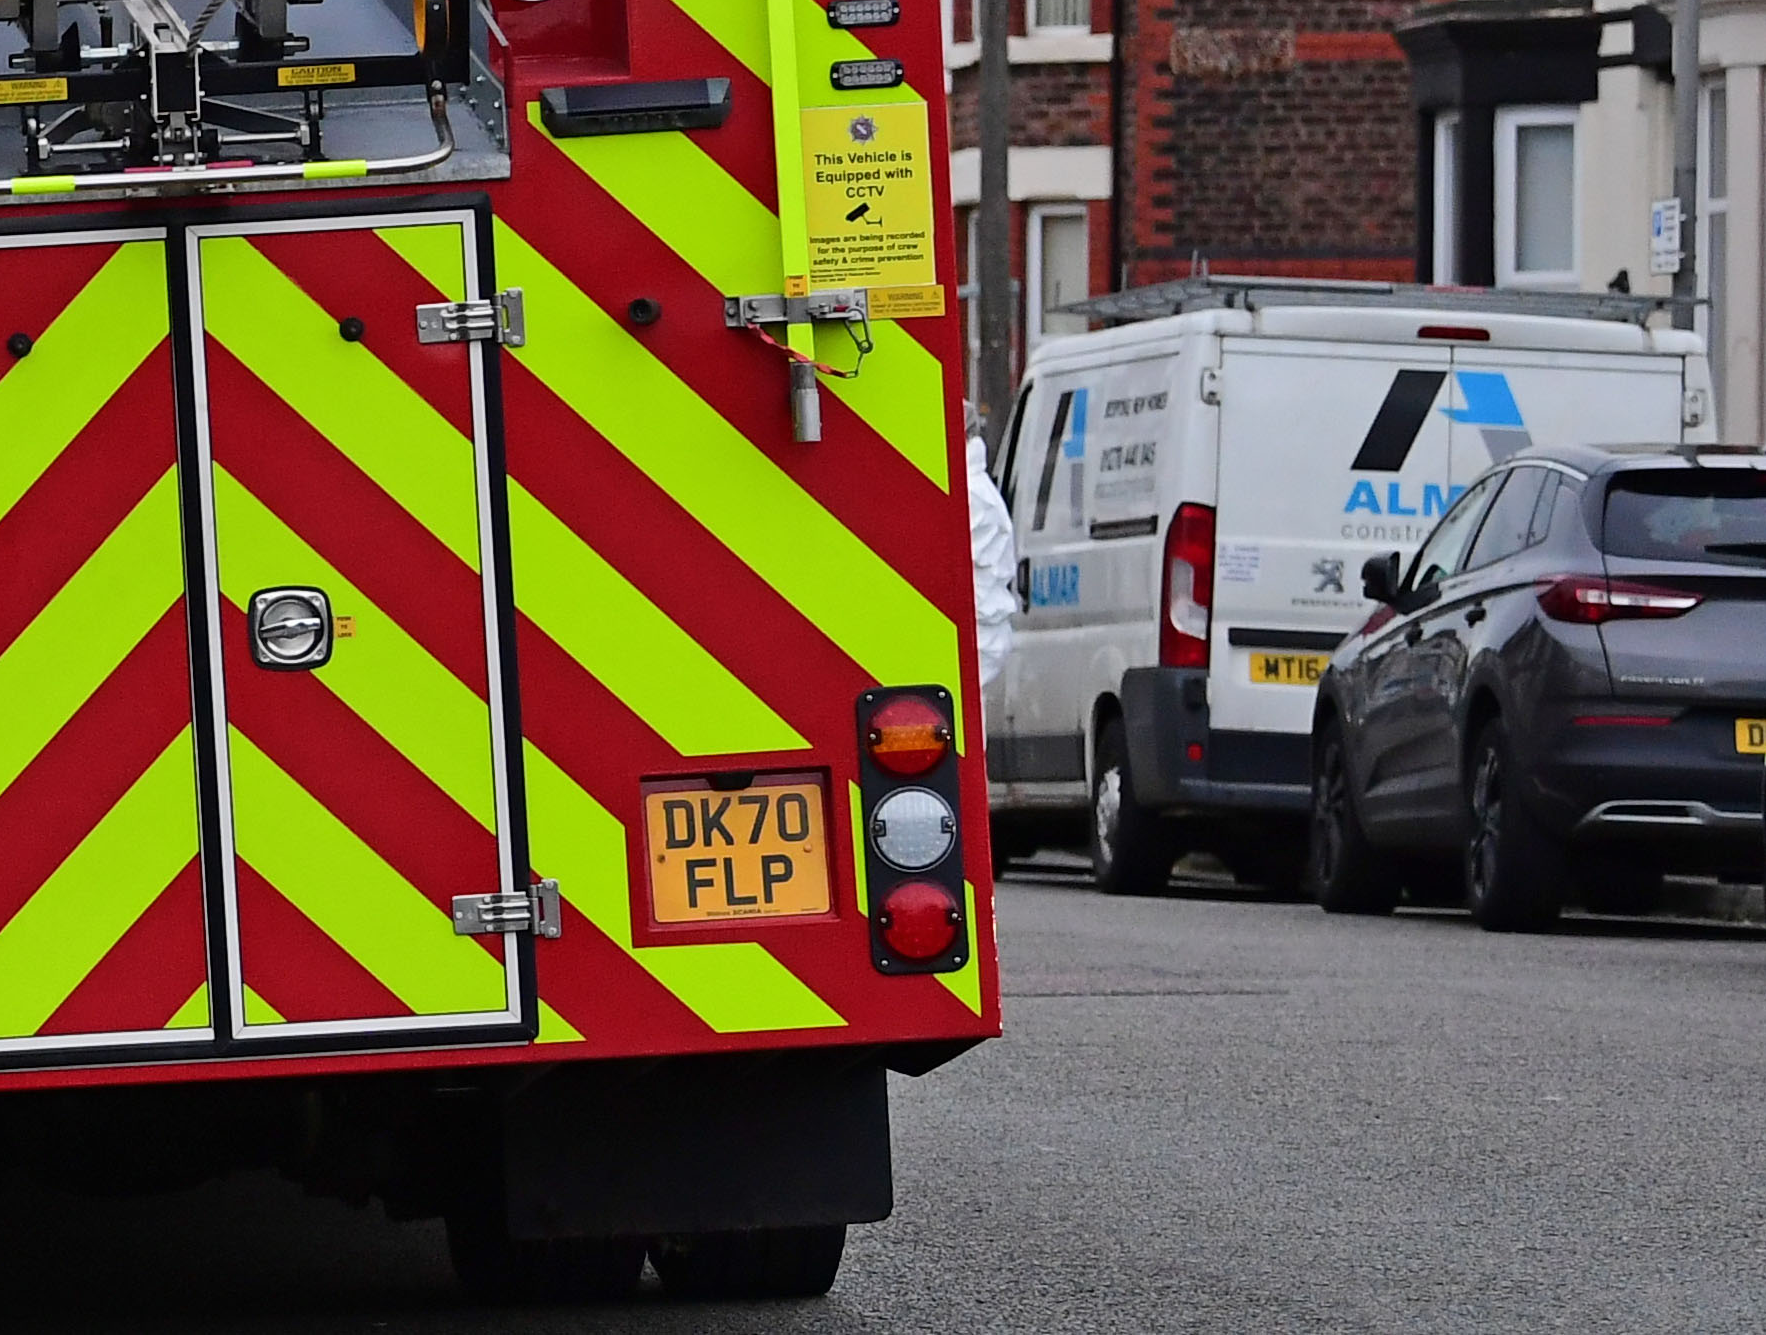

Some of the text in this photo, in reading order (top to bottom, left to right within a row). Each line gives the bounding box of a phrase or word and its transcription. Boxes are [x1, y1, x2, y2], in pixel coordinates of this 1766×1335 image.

[814, 150, 913, 165] This Vehicle is
[816, 168, 913, 184] Equipped with
[846, 186, 885, 198] CCTV
[809, 236, 841, 245] Images
[859, 234, 884, 242] being
[886, 231, 925, 240] recorded
[817, 246, 829, 254] for
[848, 245, 884, 254] purpose
[886, 243, 896, 251] of
[813, 258, 839, 266] safety
[850, 256, 875, 264] crime
[877, 254, 924, 263] prevention
[1344, 479, 1469, 517] ALM
[1264, 657, 1321, 680] MT16
[663, 793, 810, 850] DK70
[685, 854, 794, 909] FLP
